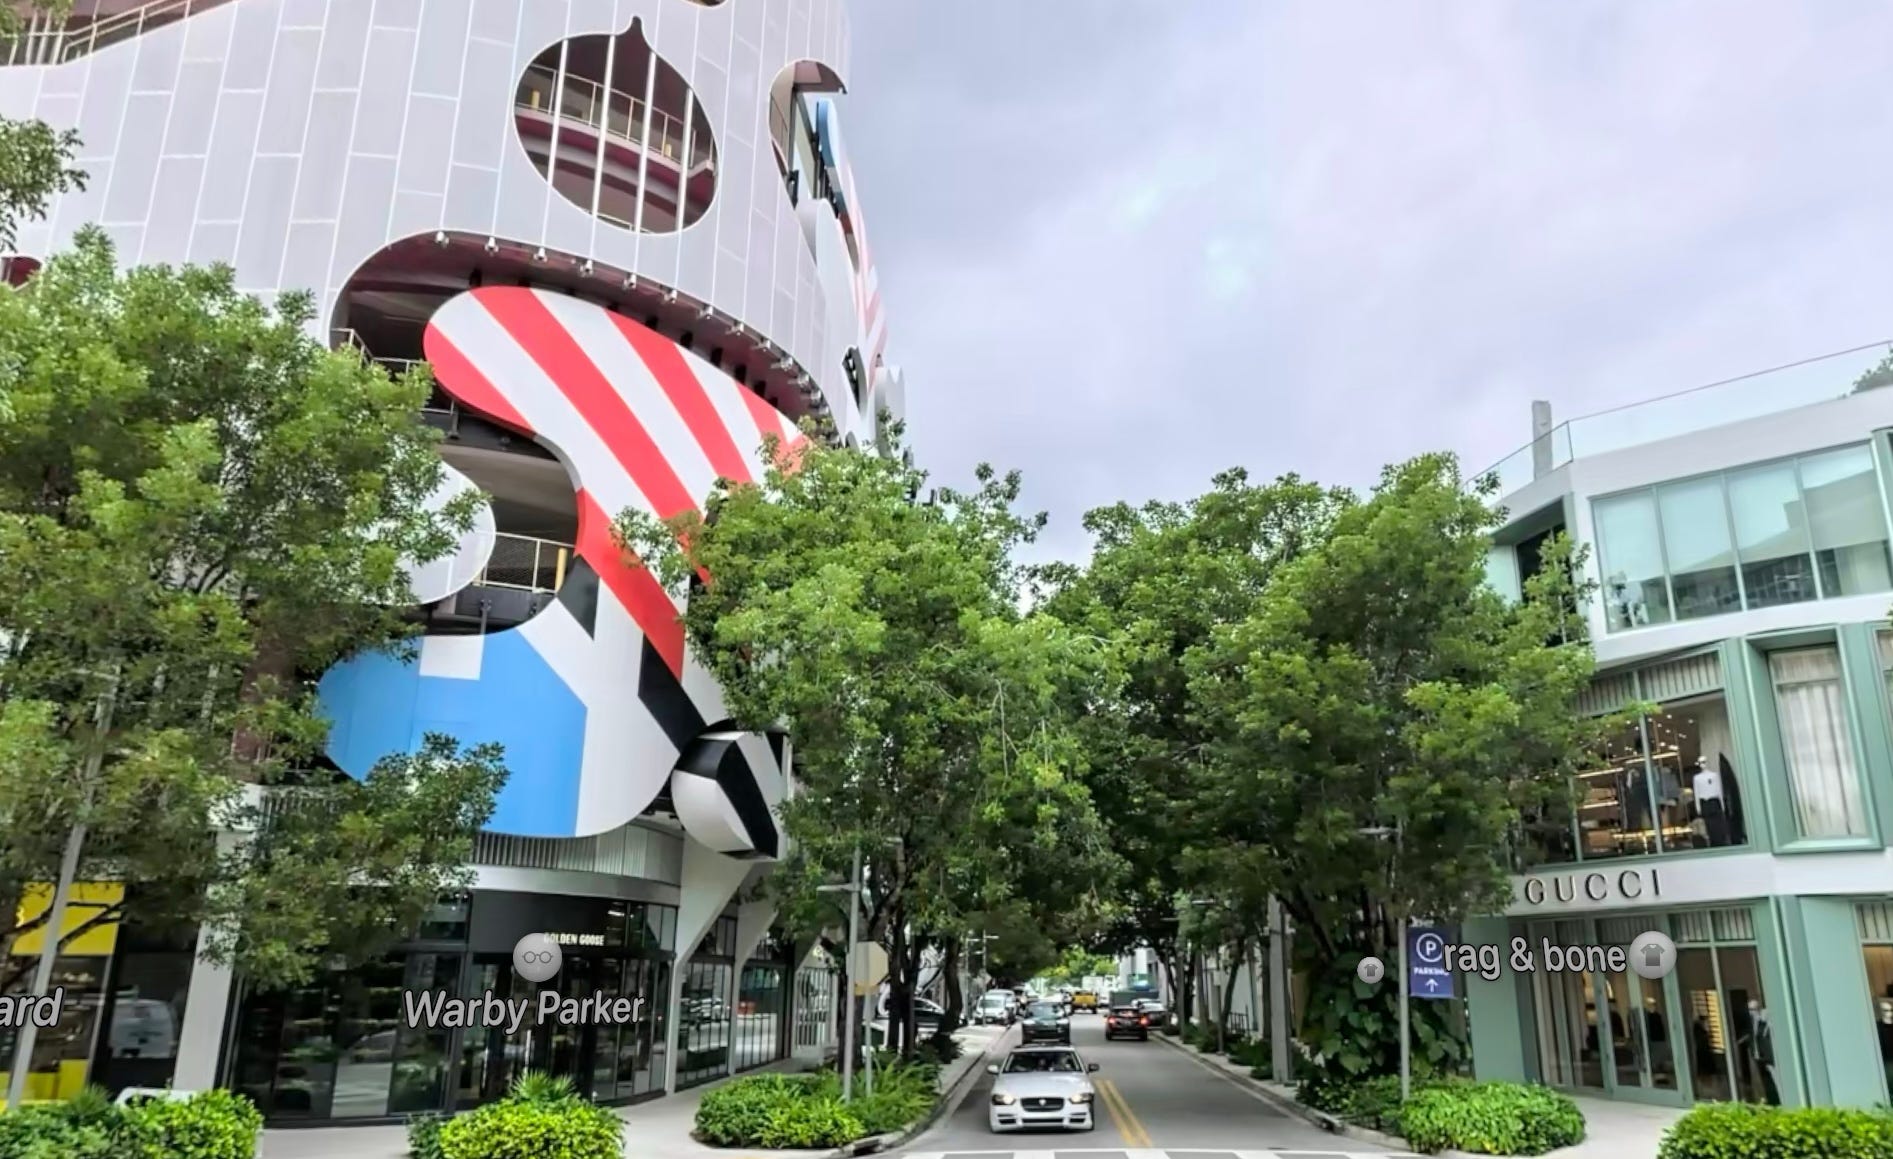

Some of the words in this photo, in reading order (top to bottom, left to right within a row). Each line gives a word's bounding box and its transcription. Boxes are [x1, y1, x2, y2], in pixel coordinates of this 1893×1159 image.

[1525, 869, 1661, 904] GUCCI
[579, 934, 604, 946] GOOSE
[1425, 940, 1437, 956] P
